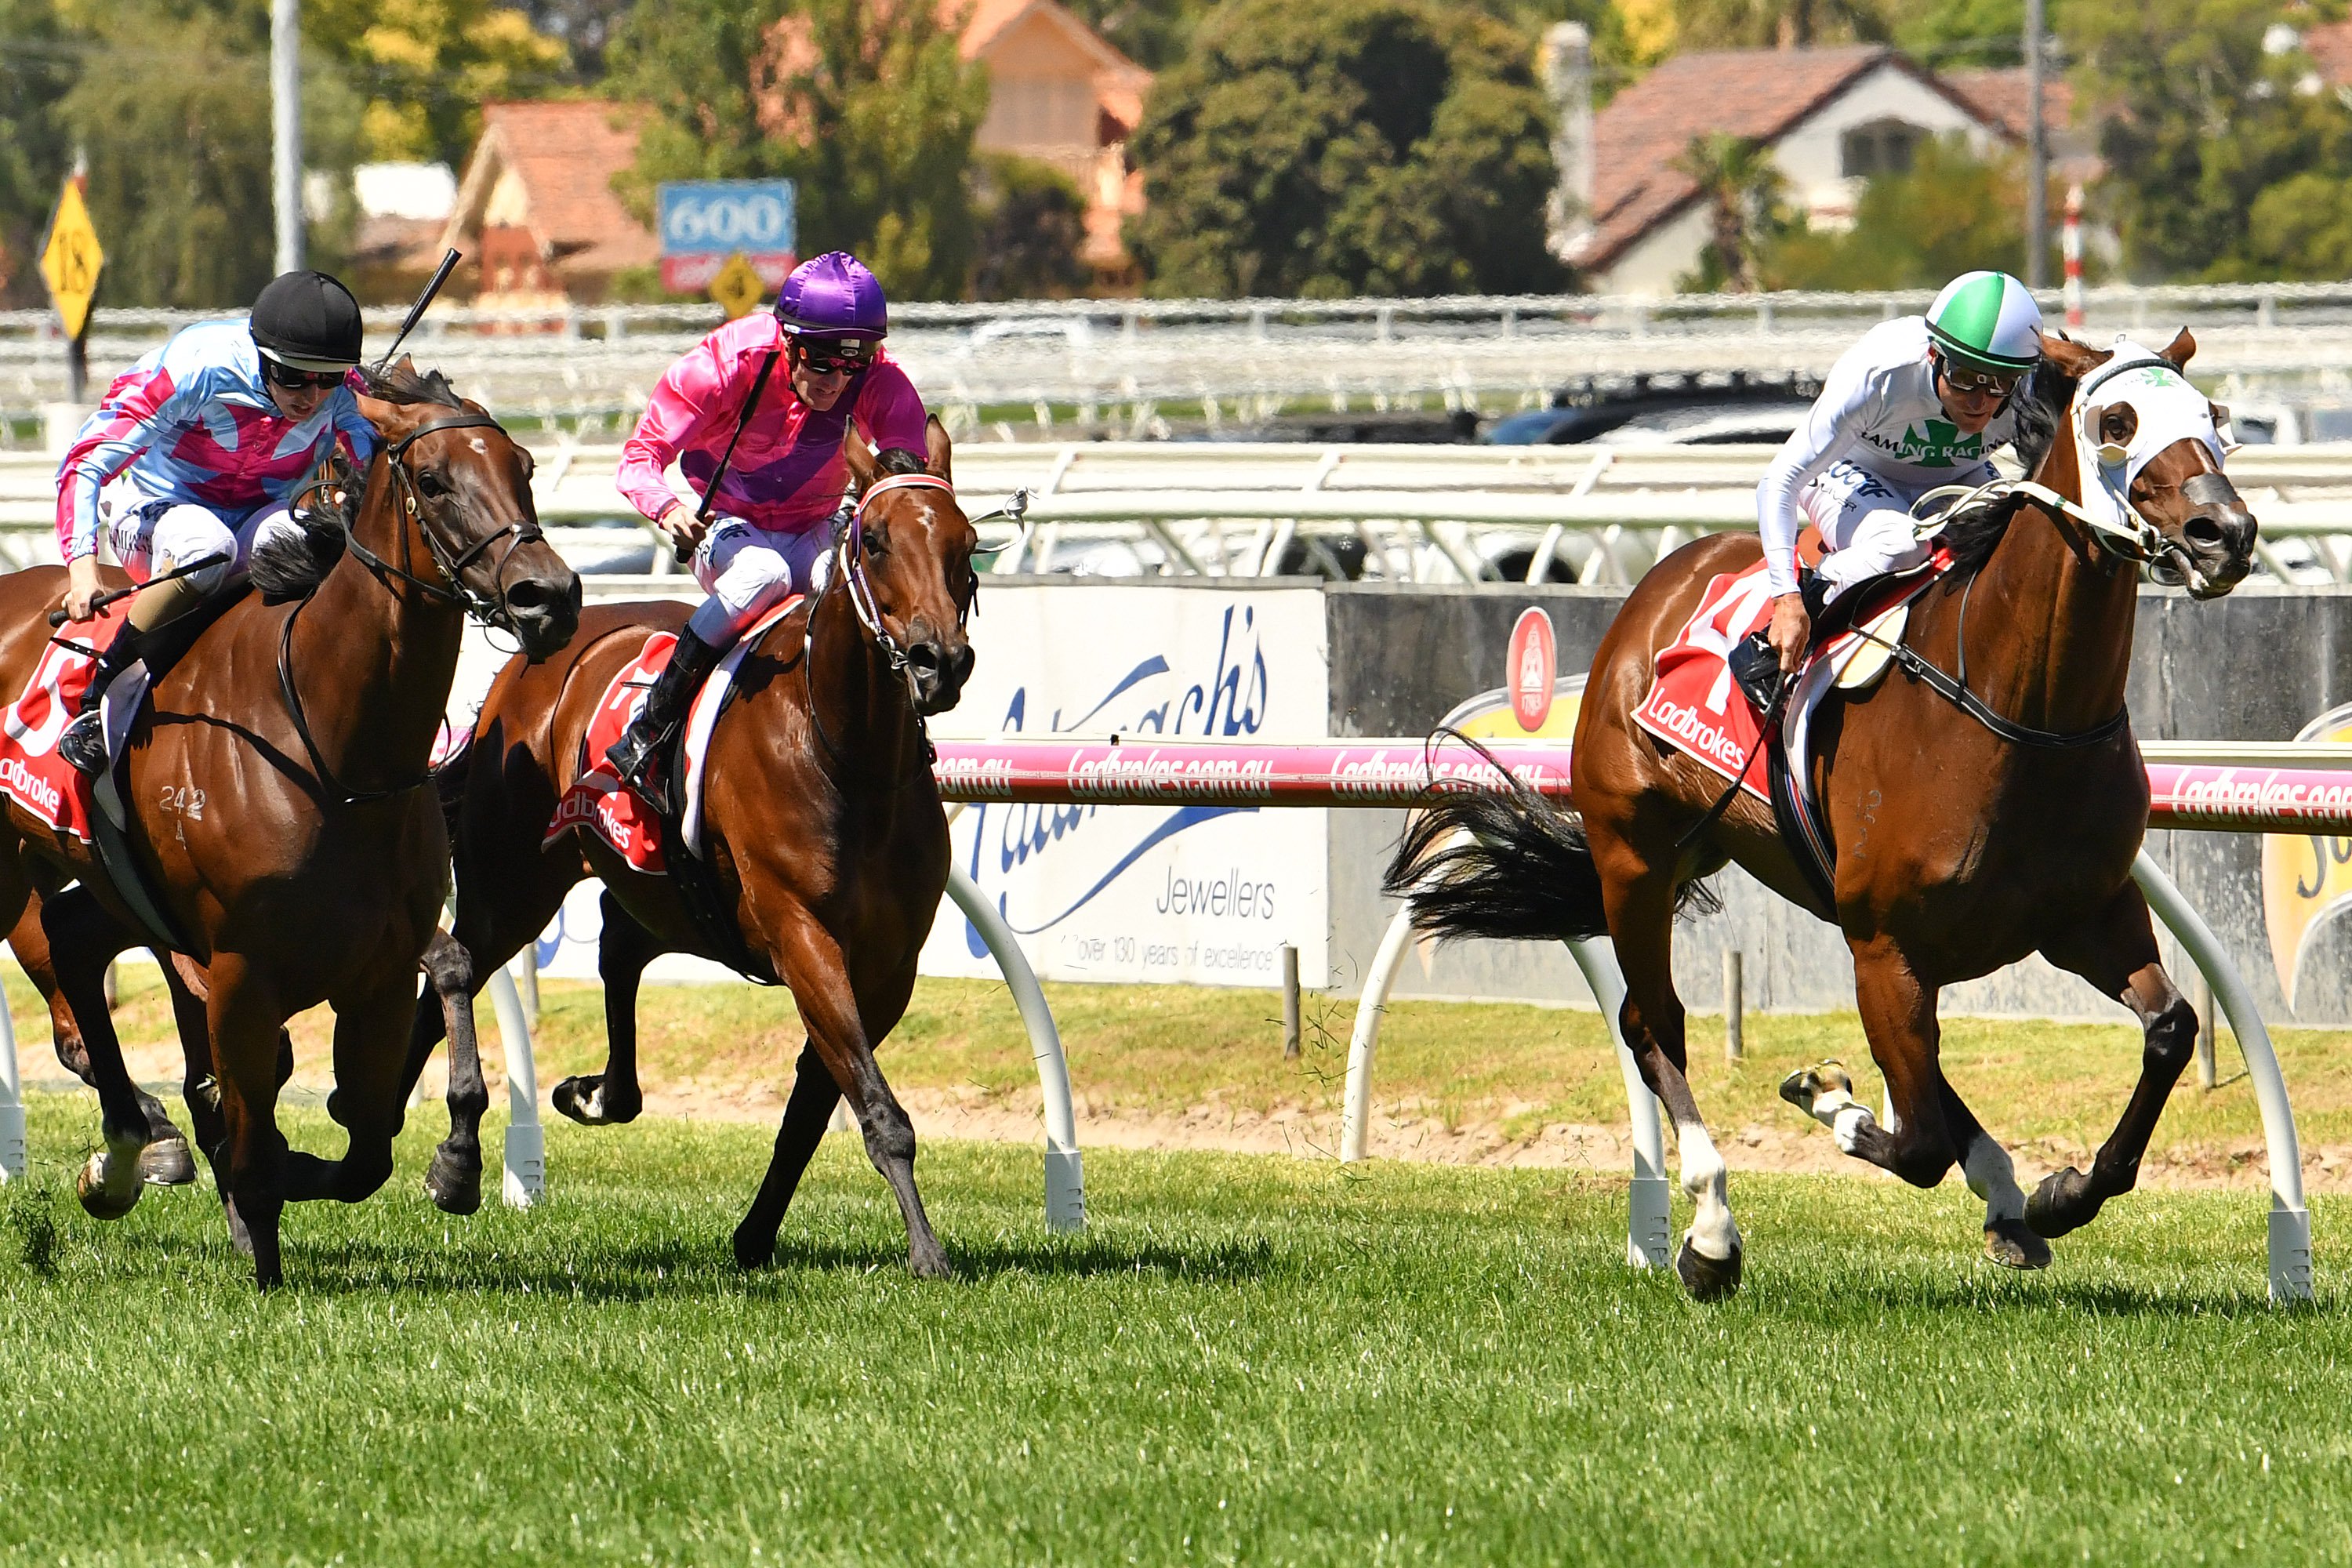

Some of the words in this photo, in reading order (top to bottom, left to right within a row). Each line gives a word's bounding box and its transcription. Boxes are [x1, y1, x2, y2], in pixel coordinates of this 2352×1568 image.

[670, 195, 782, 242] 600
[1648, 687, 1745, 770] Ladbrokes
[0, 757, 60, 817] adbroke
[1068, 749, 1272, 798] Ladbrokes.com.au
[159, 786, 205, 821] 242
[1156, 866, 1276, 920] Jewellers
[1078, 939, 1106, 961] over
[1115, 936, 1135, 963] 130
[1142, 944, 1178, 971] years
[1204, 942, 1273, 971] excellence
